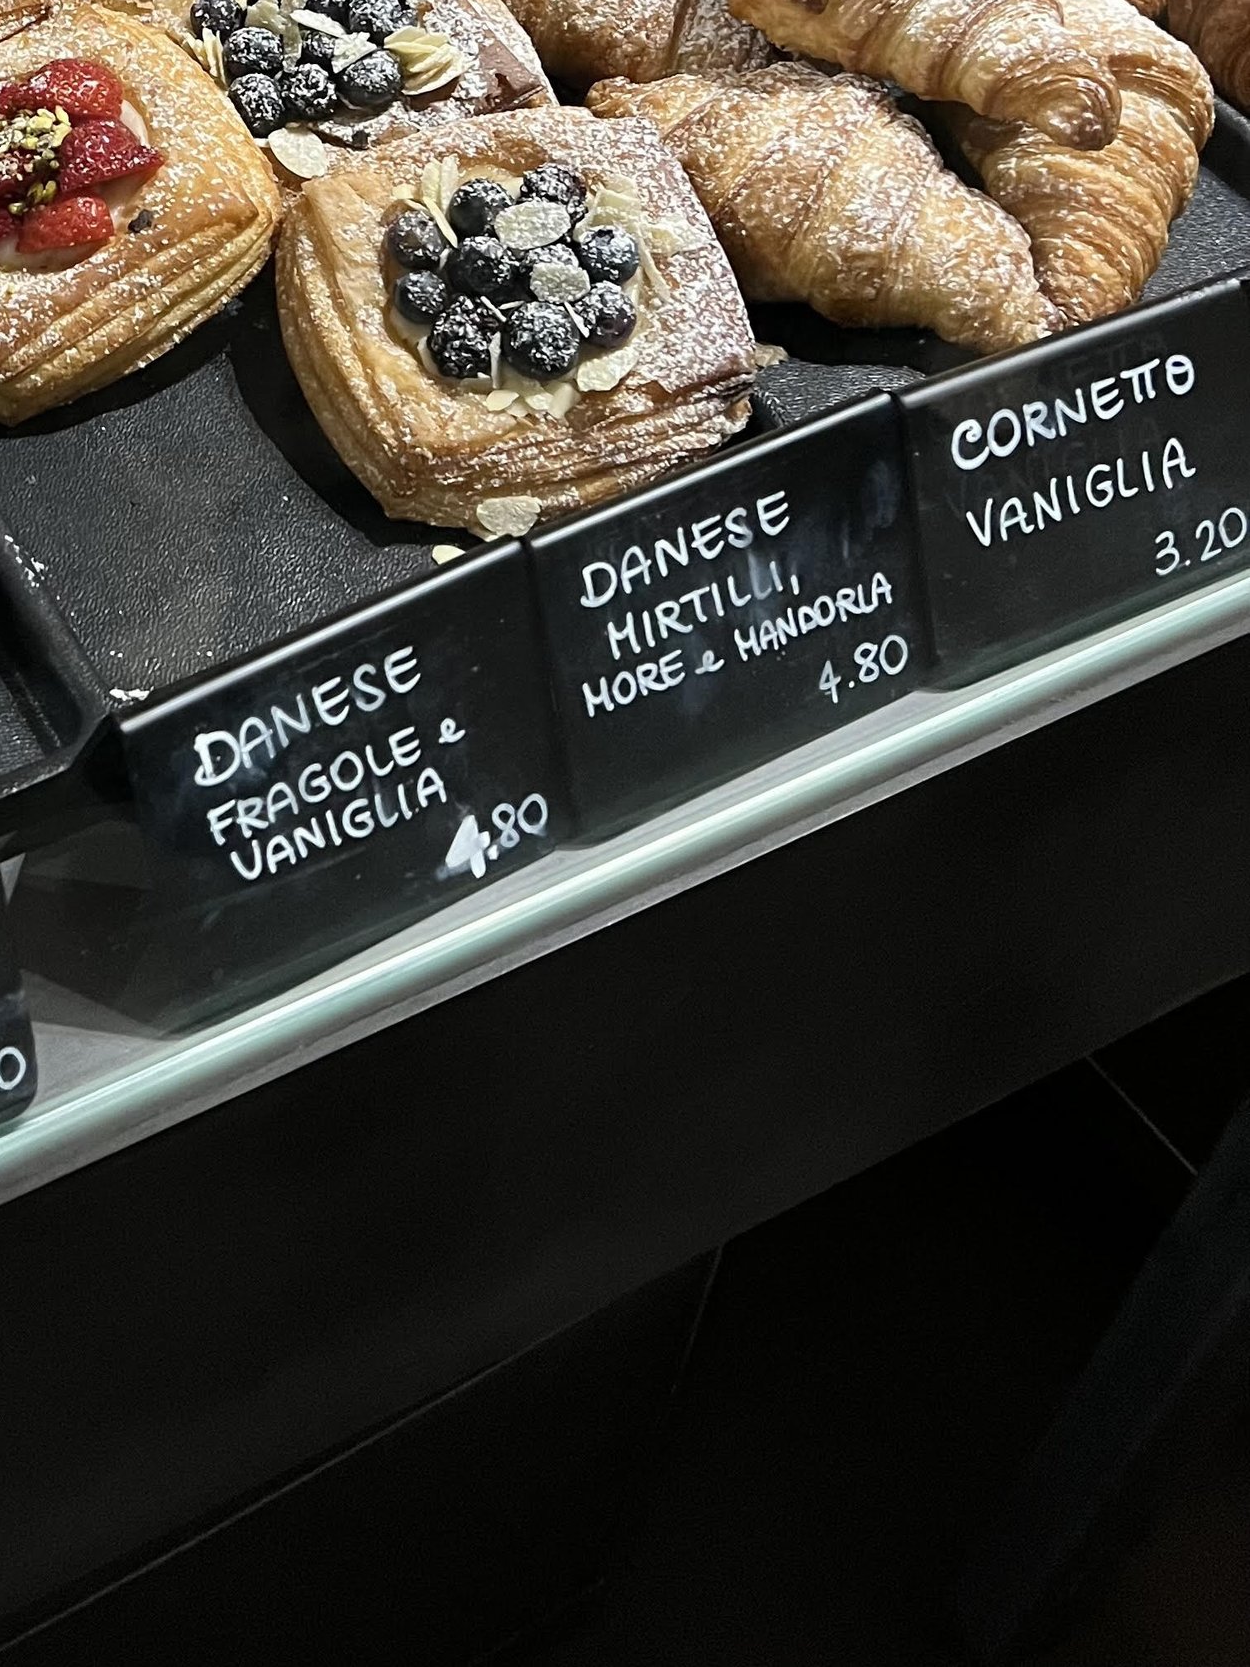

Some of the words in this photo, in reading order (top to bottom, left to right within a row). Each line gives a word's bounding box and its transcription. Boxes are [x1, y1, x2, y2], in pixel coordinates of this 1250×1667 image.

[951, 354, 1195, 470] CORNETTO
[580, 490, 790, 607] DANESE
[966, 437, 1196, 547] VANIGLIA
[1155, 507, 1248, 576] 3.20
[582, 649, 685, 717] MORE
[733, 572, 893, 661] MANDORLA
[819, 634, 909, 704] 4.80
[194, 646, 421, 786] DANESE
[207, 726, 421, 845] FRAGOLE
[230, 767, 447, 880] VANIGLIA
[443, 793, 548, 878] 4.80
